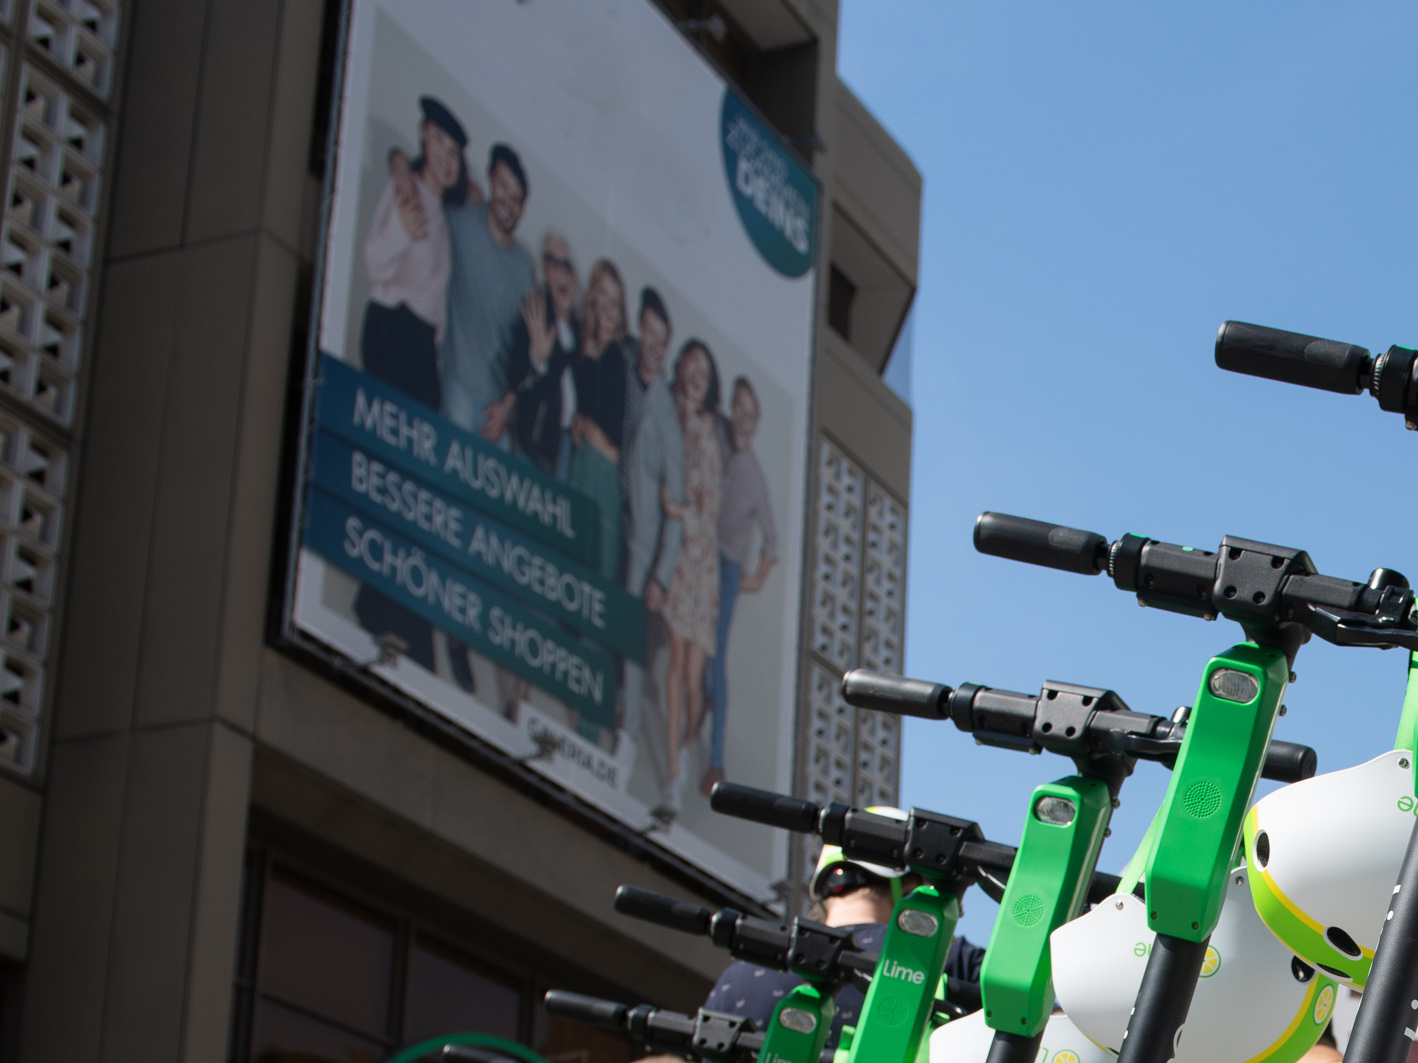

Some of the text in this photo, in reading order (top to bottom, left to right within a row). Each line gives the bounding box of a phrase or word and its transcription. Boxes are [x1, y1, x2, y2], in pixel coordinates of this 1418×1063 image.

[351, 450, 606, 628] BESSERE ANGEBOTE
[353, 387, 575, 538] MEHR AUSWAHL
[343, 516, 604, 705] SCHÖNER SHOPPEN
[883, 959, 925, 984] Lime
